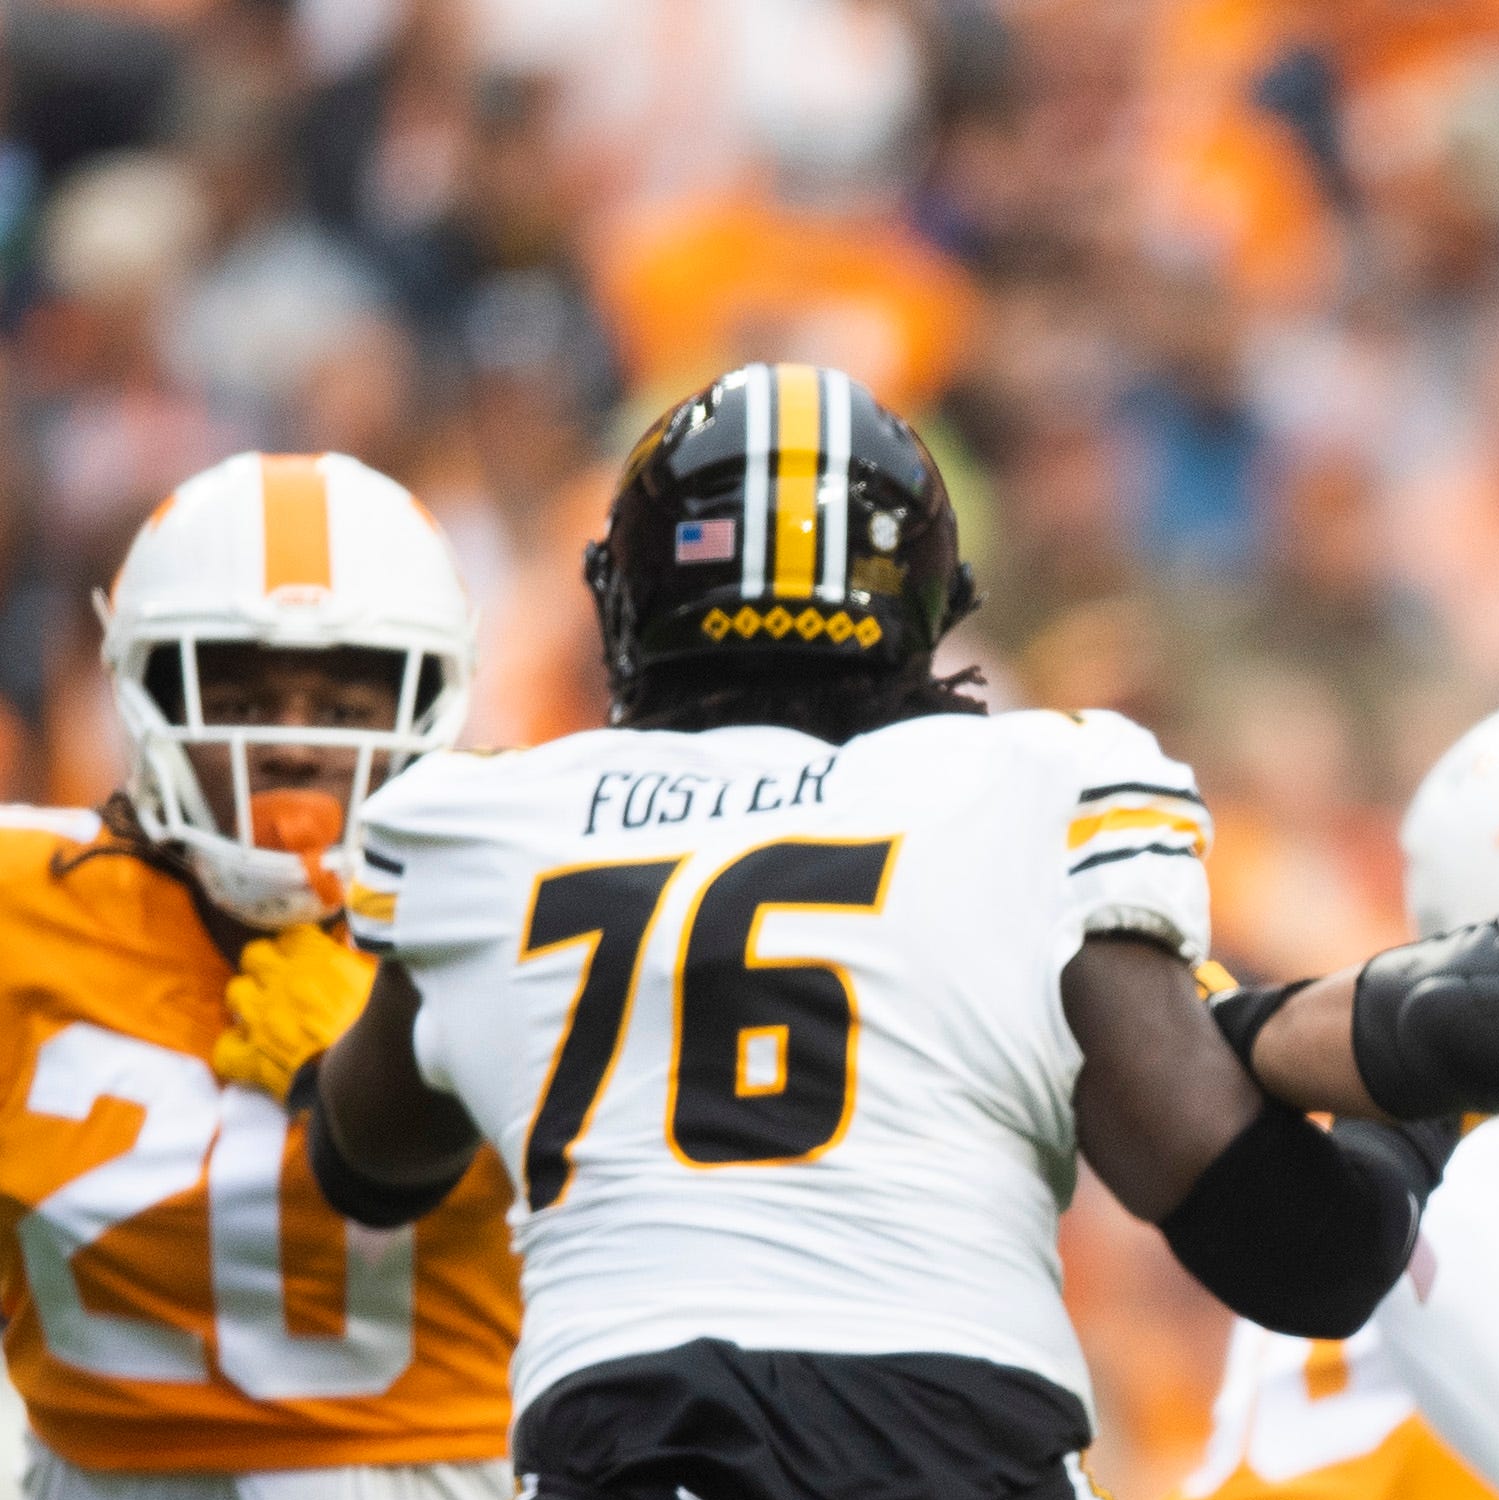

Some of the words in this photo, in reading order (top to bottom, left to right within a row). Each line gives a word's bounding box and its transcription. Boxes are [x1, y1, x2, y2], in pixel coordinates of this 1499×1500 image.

[582, 755, 837, 836] FOSTER
[17, 1020, 416, 1403] 20
[517, 832, 906, 1214] 76
